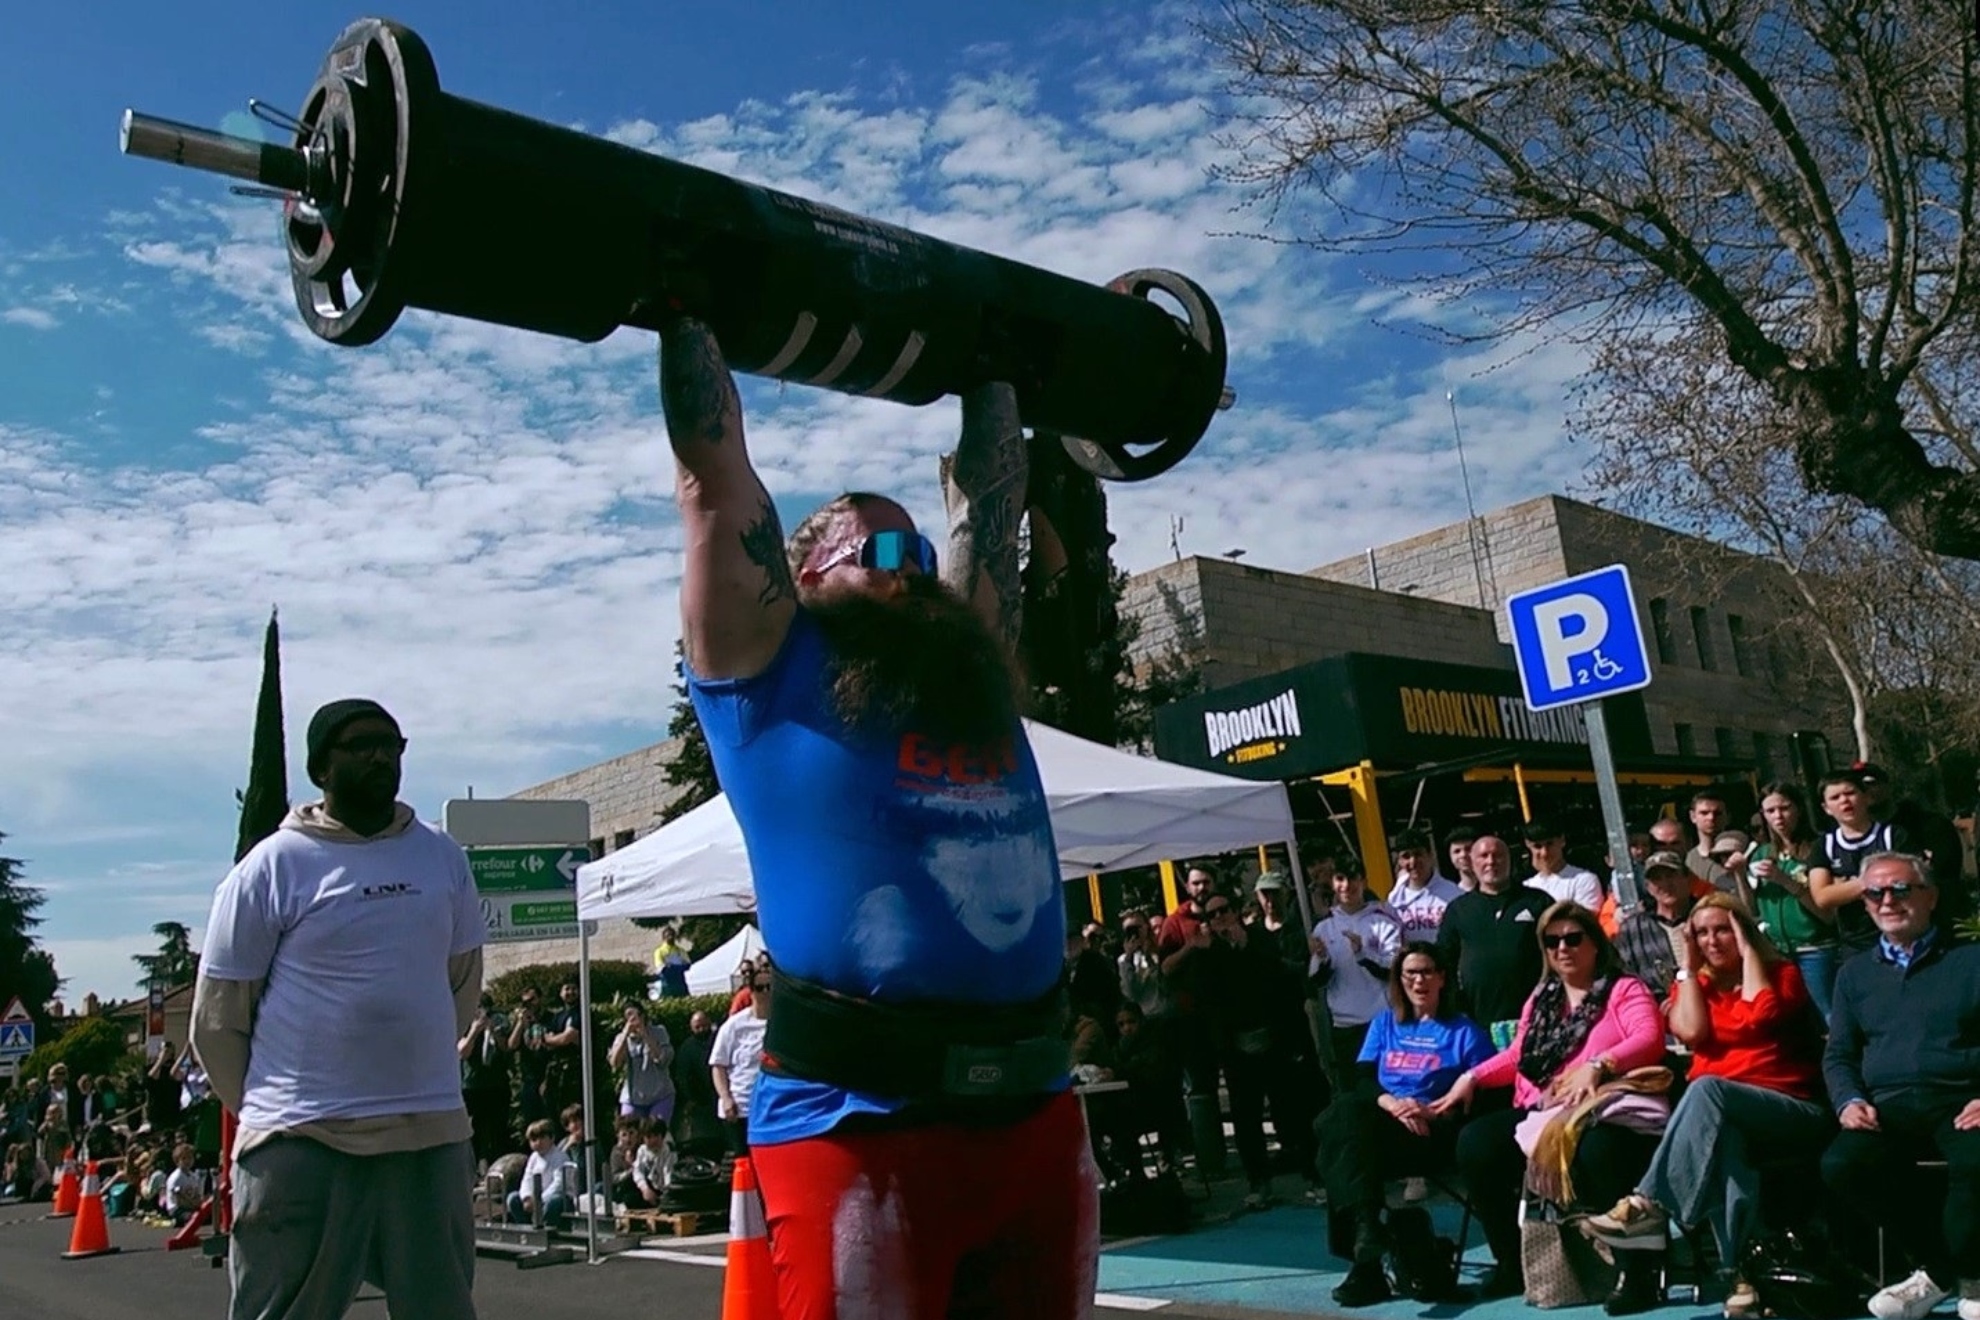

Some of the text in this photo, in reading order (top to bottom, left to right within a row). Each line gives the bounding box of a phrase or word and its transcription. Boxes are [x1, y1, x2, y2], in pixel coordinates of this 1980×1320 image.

[1533, 593, 1608, 691] P
[1577, 669, 1590, 685] 2
[1205, 689, 1301, 757] BROOKLYN
[1400, 687, 1588, 744] BROOKLYN FITBOXING
